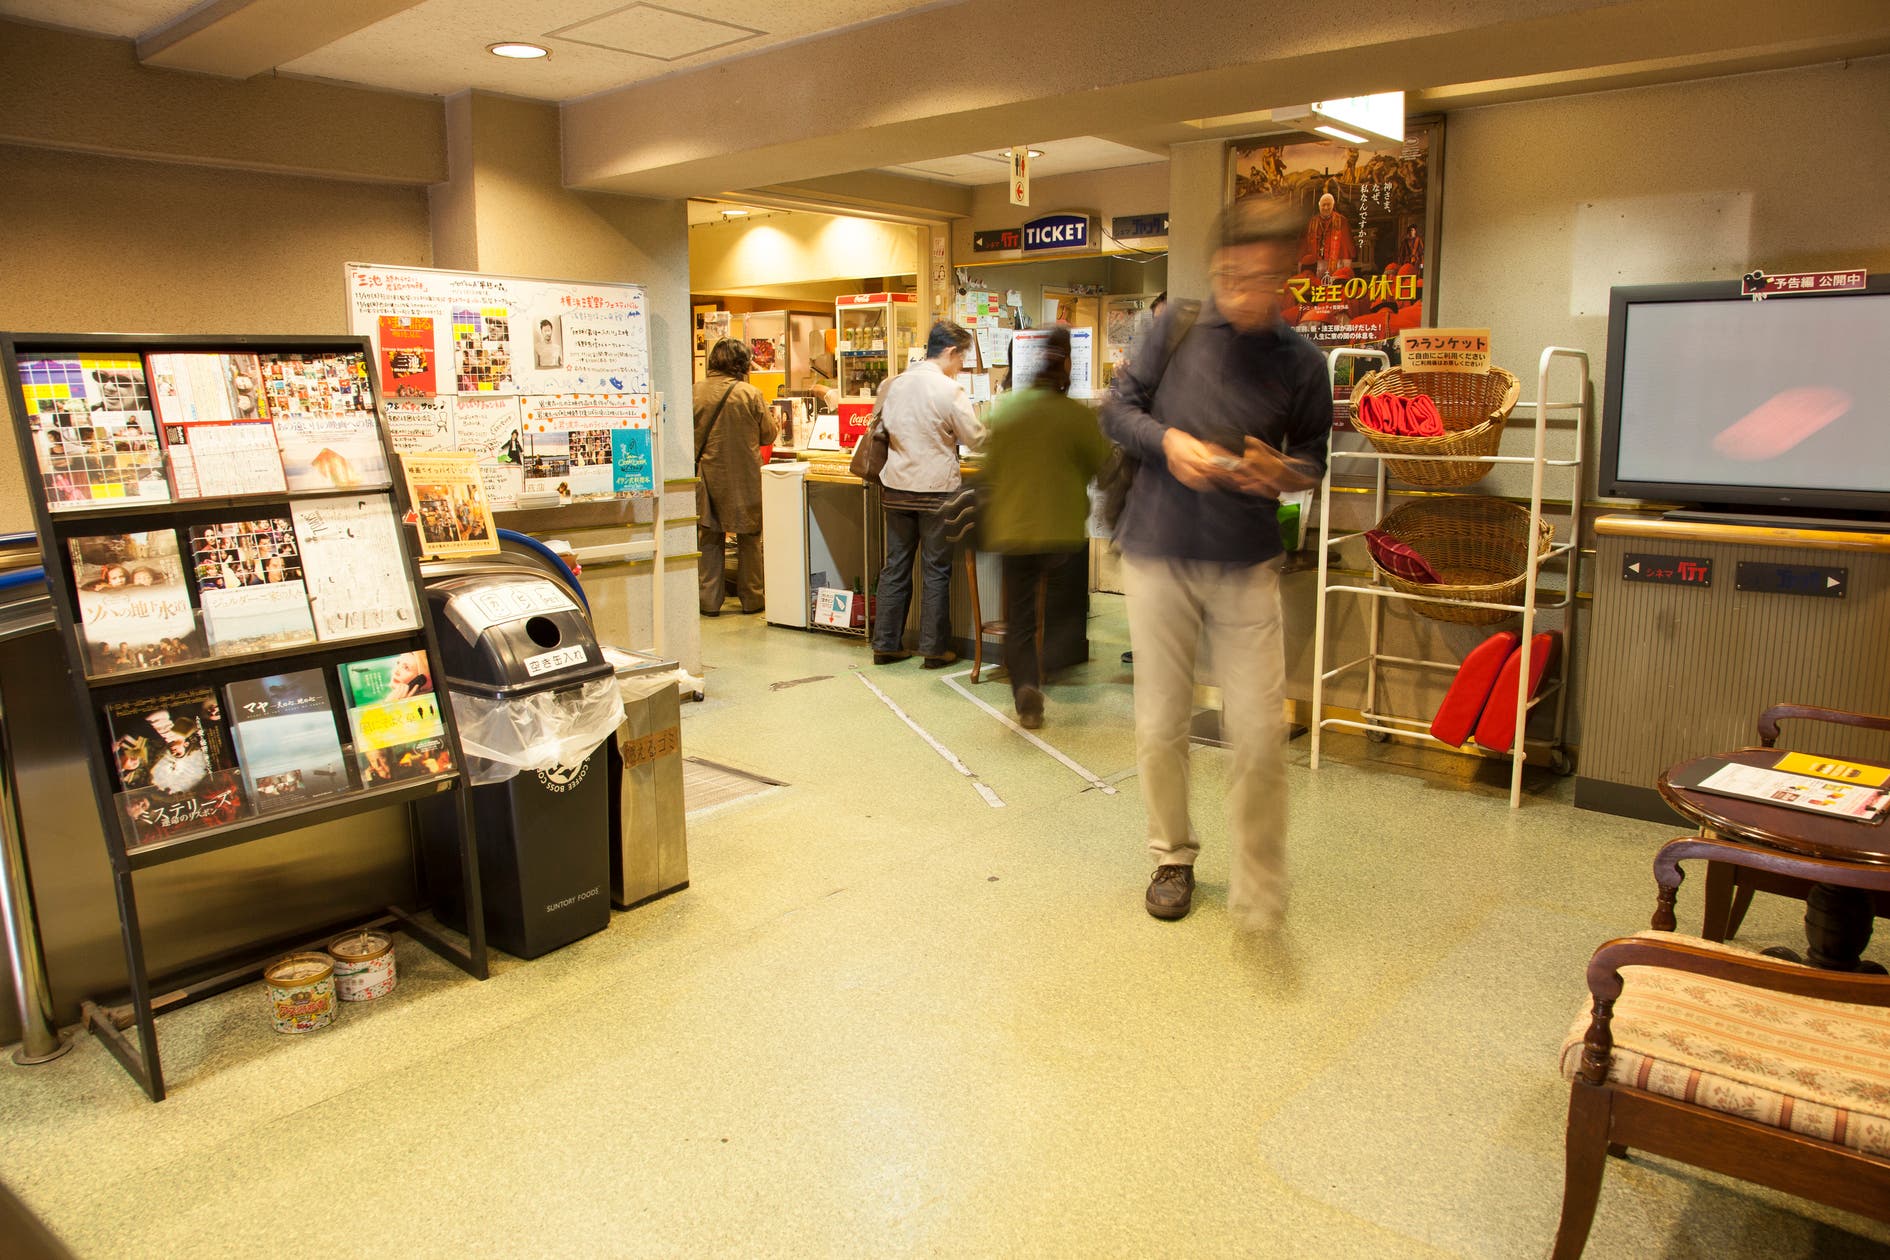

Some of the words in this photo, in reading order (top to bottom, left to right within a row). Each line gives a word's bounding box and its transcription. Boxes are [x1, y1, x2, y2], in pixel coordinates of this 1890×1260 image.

[1026, 222, 1085, 245] TICKET
[1774, 276, 1815, 290] 予告編
[1819, 273, 1861, 288] 公開中
[1406, 337, 1486, 350] ブランケット
[1407, 351, 1486, 361] ご自由にご利用ください
[1646, 567, 1674, 579] シネマ
[529, 650, 584, 673] 空き缶入れ
[546, 782, 565, 793] BOSS
[140, 789, 233, 825] ミステリーズ
[546, 897, 576, 913] SUNTORY
[577, 886, 600, 901] FOODS
